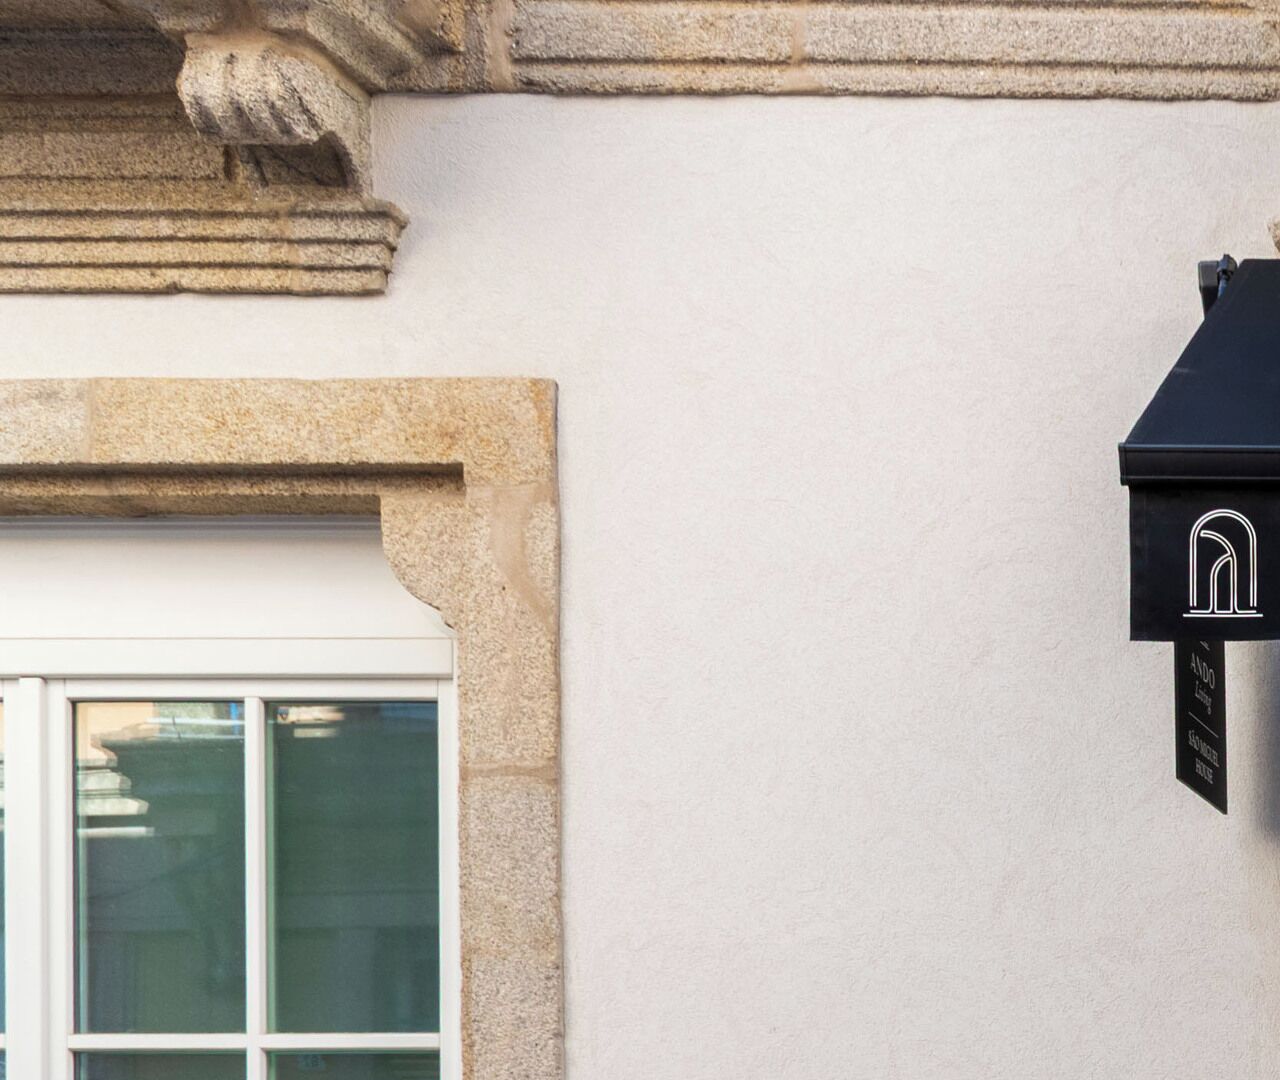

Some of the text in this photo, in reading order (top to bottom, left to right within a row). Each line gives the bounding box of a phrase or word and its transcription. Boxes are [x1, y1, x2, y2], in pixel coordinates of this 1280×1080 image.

[1190, 652, 1216, 689] ANDO
[1195, 680, 1212, 716] Living
[1195, 758, 1214, 785] HOUSE
